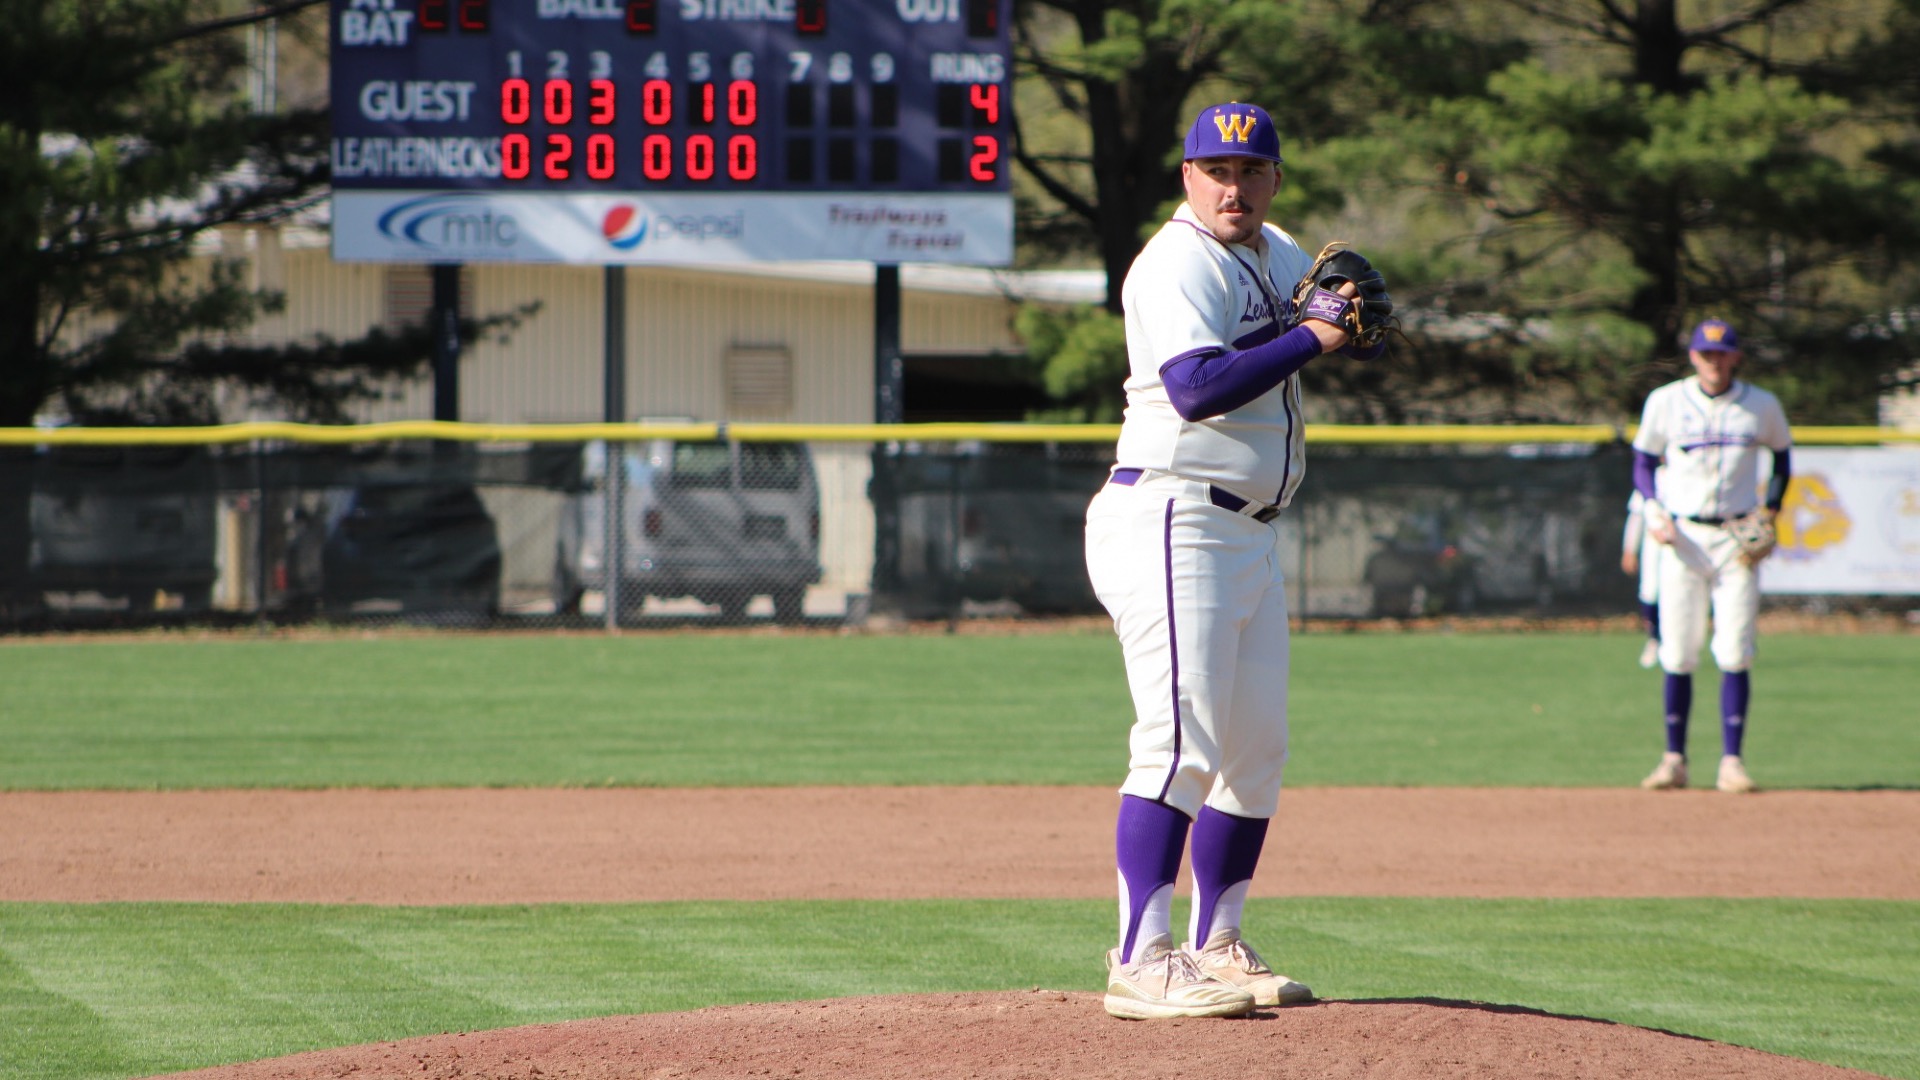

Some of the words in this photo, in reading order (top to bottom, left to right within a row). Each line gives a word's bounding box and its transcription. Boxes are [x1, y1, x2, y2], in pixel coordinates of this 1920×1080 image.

[340, 10, 413, 45] BAT
[507, 51, 522, 78] 1
[547, 51, 568, 79] 2
[590, 51, 611, 79] 3
[644, 52, 668, 79] 4
[688, 52, 711, 80] 5
[730, 52, 753, 80] 6
[788, 51, 813, 81] 7
[829, 52, 852, 82] 8
[871, 53, 894, 82] 9
[930, 53, 1004, 83] RUNS
[359, 80, 476, 121] GUEST
[501, 78, 530, 125] 0
[544, 78, 573, 125] 0
[589, 79, 615, 125] 3
[643, 79, 672, 126] 0
[702, 82, 714, 123] 1
[728, 79, 757, 126] 0
[969, 83, 998, 124] 4
[1214, 114, 1257, 143] W
[332, 136, 501, 177] LEATHERNECKS
[501, 132, 530, 180] 0
[544, 133, 573, 180] 2
[586, 133, 615, 180] 0
[643, 133, 672, 180] 0
[686, 133, 715, 181] 0
[728, 133, 757, 181] 0
[969, 135, 998, 182] 2
[441, 209, 519, 246] mtc
[653, 208, 745, 243] pepsi
